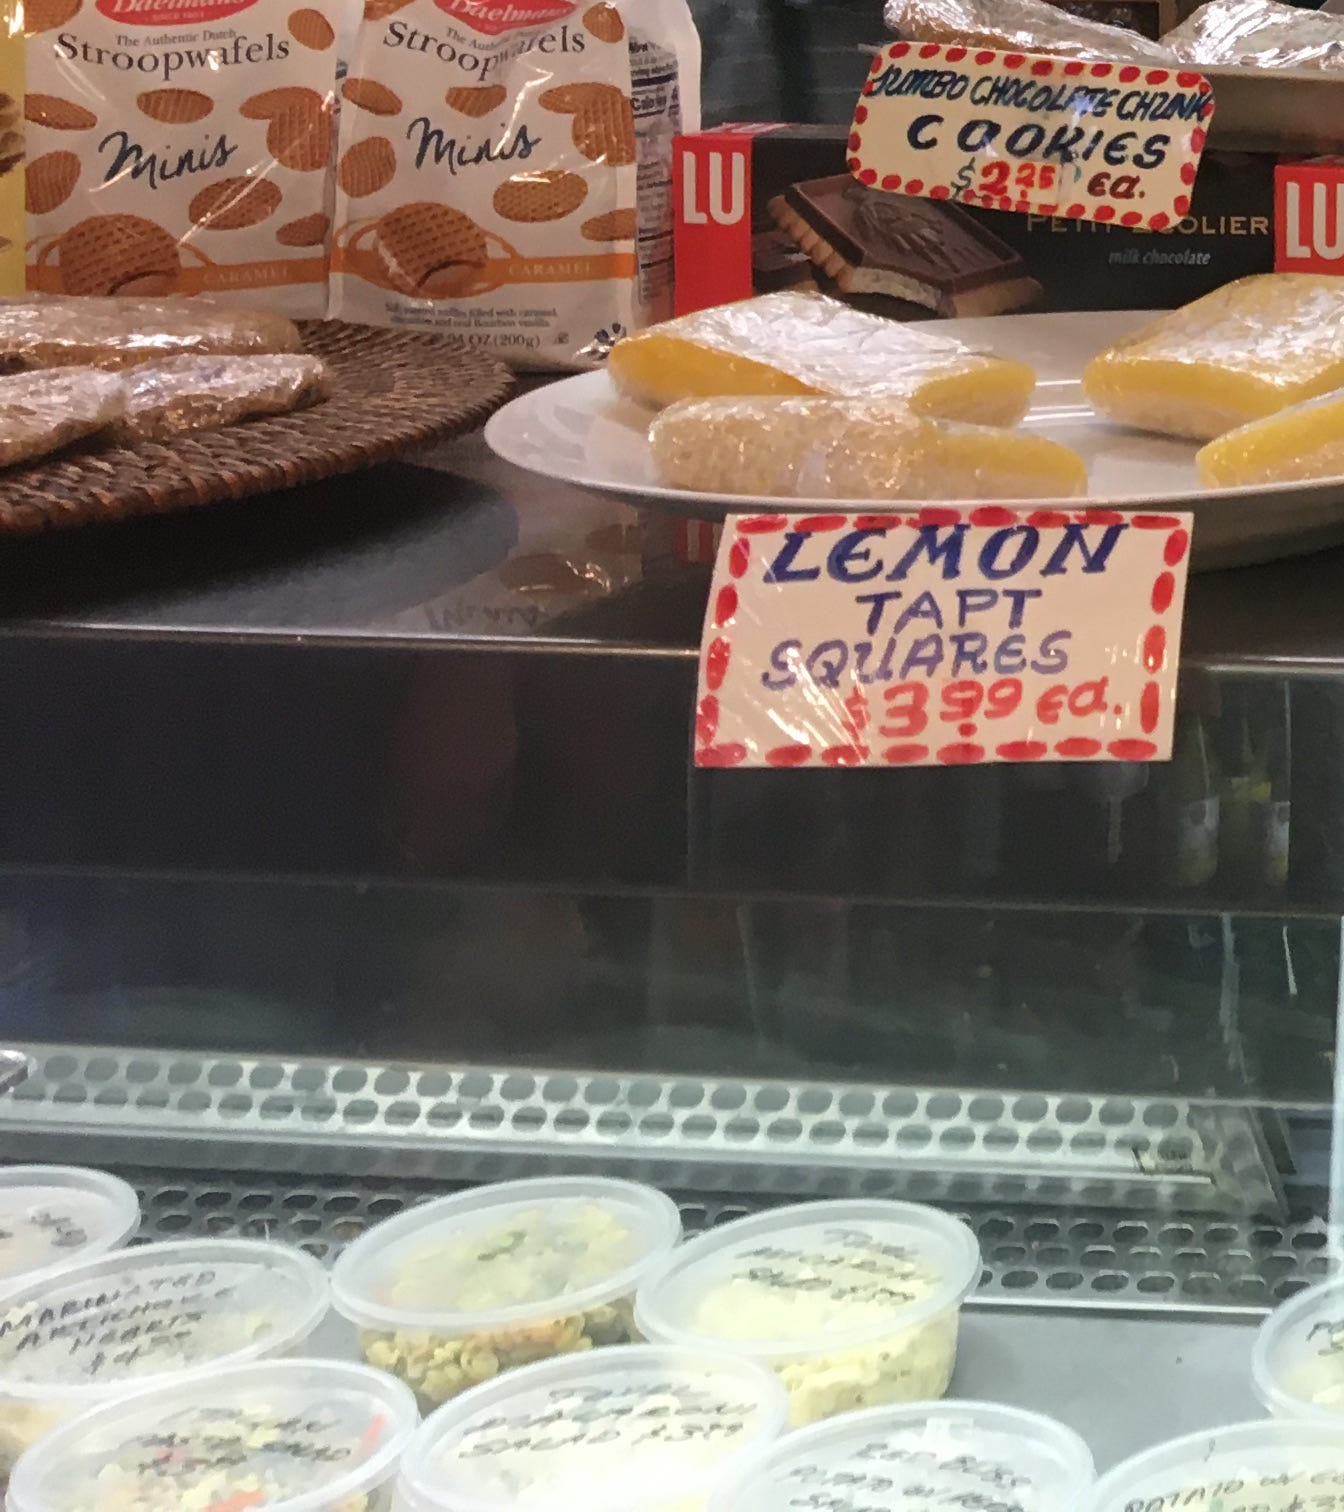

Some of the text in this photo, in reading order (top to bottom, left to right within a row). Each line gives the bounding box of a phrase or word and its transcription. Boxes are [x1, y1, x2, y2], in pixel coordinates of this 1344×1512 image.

[54, 31, 294, 82] Stroopwafels
[864, 63, 1213, 126] JUMBO CHOCOLATE CHUNK
[98, 128, 241, 191] Minis
[406, 116, 544, 178] Minis
[905, 113, 1174, 172] COOKIES
[683, 150, 747, 226] LU
[762, 521, 1131, 585] LEMON
[760, 628, 1075, 692] SQUARES
